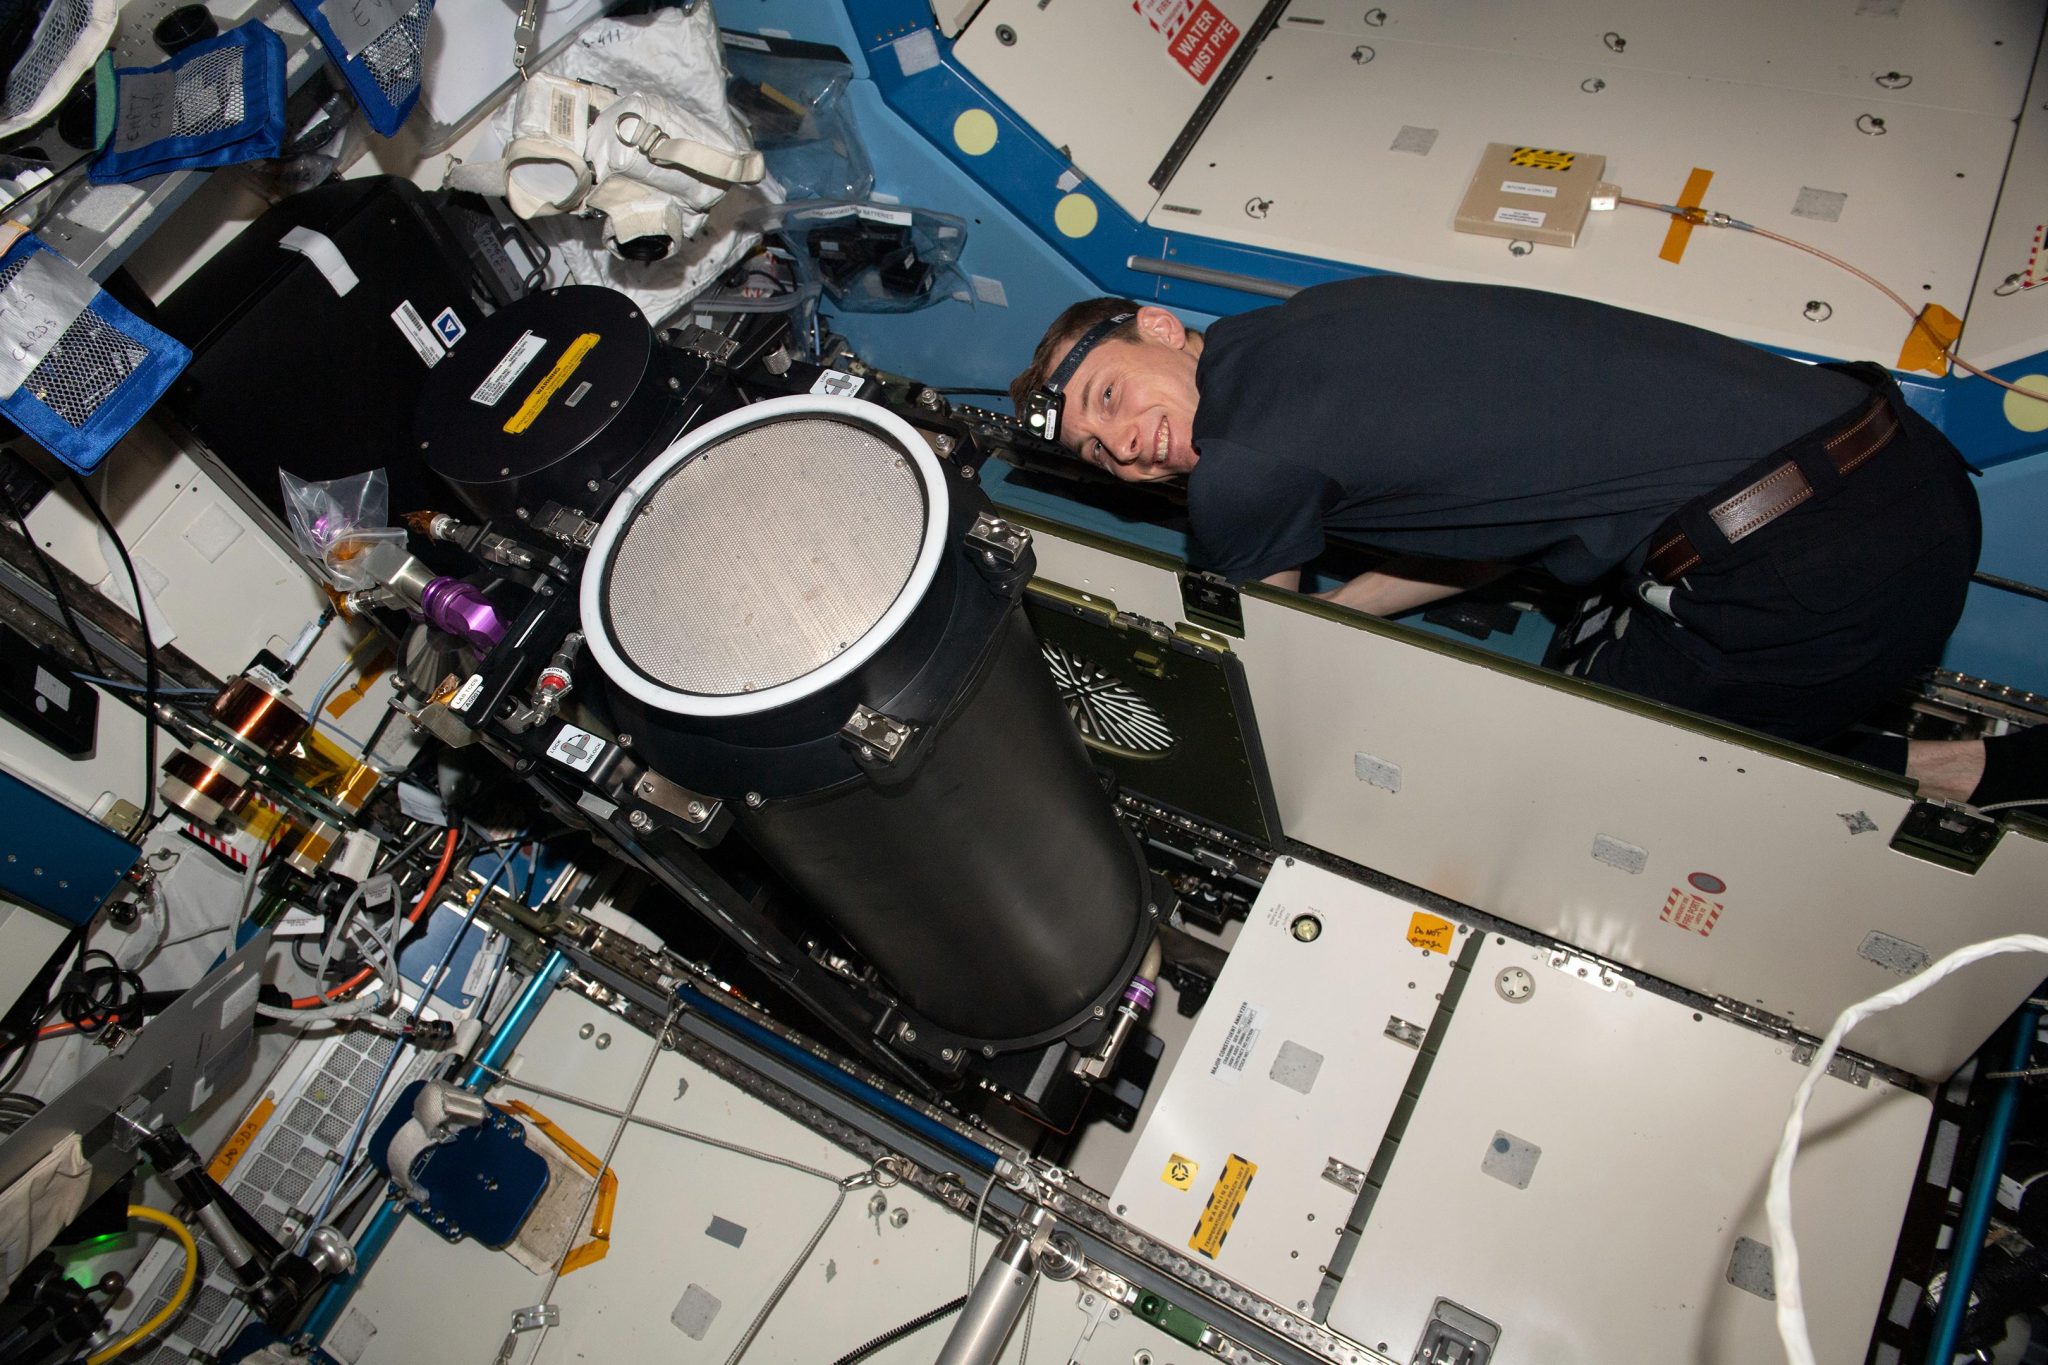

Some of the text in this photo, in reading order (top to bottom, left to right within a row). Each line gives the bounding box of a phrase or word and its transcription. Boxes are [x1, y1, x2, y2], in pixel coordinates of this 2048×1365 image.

[1177, 9, 1212, 56] WATER
[1188, 20, 1234, 76] MIST PFE
[12, 318, 57, 361] CARDS
[533, 366, 563, 395] WARNING
[455, 677, 478, 705] LAB TCCS
[548, 739, 562, 754] LOCK
[582, 742, 604, 764] UNLOCK
[1210, 1057, 1222, 1075] MAJOR
[1219, 1025, 1237, 1058] CONSTITUENT
[1233, 1001, 1248, 1026] ANALYZER
[1203, 1209, 1225, 1247] TEMPERATURE
[1221, 1197, 1230, 1210] MAY
[1226, 1179, 1239, 1198] REACH
[1206, 1182, 1229, 1223] WARNING
